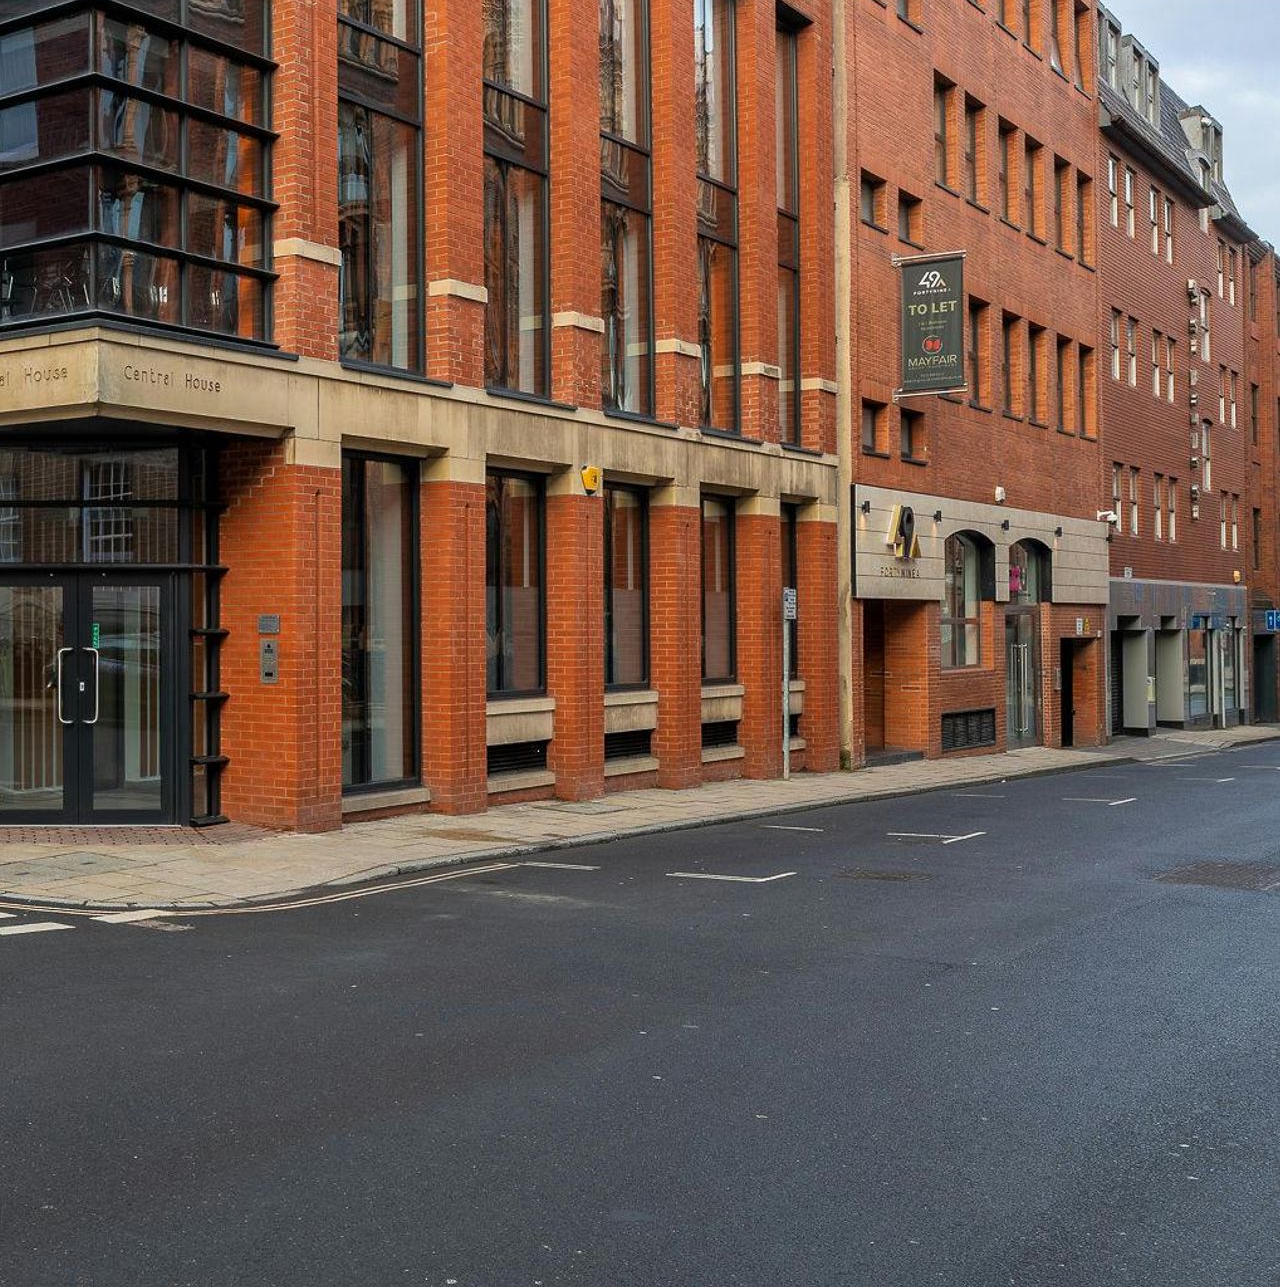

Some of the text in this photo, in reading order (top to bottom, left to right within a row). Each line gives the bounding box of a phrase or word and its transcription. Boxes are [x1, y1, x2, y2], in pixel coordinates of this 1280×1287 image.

[908, 300, 957, 316] TO LET
[908, 354, 957, 367] MAYFAIR
[24, 367, 68, 384] House
[123, 365, 221, 393] Central House
